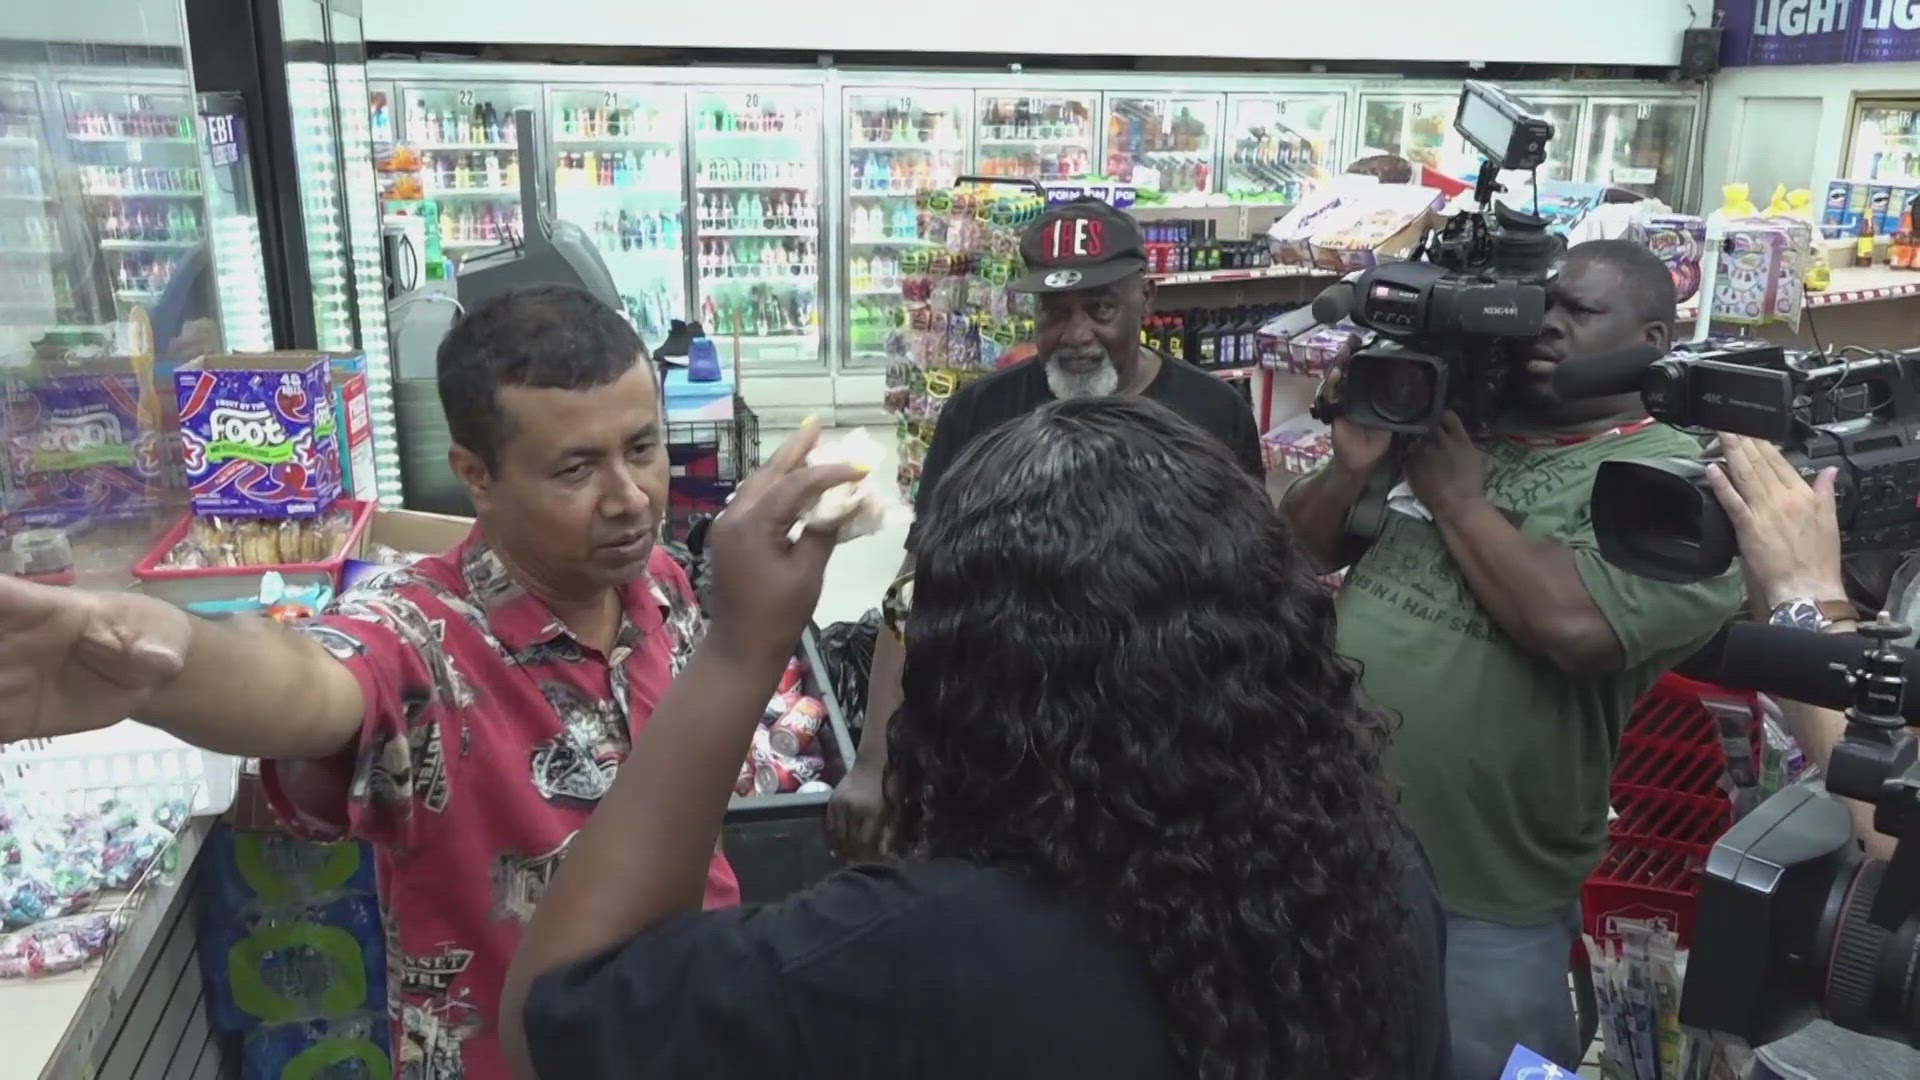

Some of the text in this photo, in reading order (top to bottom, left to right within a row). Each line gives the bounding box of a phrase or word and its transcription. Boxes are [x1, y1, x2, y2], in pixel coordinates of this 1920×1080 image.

[1753, 0, 1850, 36] LIGHT
[459, 89, 474, 106] 22
[604, 91, 618, 107] 21
[745, 93, 759, 108] 20
[900, 96, 912, 112] 19
[1412, 102, 1423, 116] 15
[208, 114, 234, 145] EBT
[216, 399, 238, 409] FRUIT
[239, 402, 249, 410] BY
